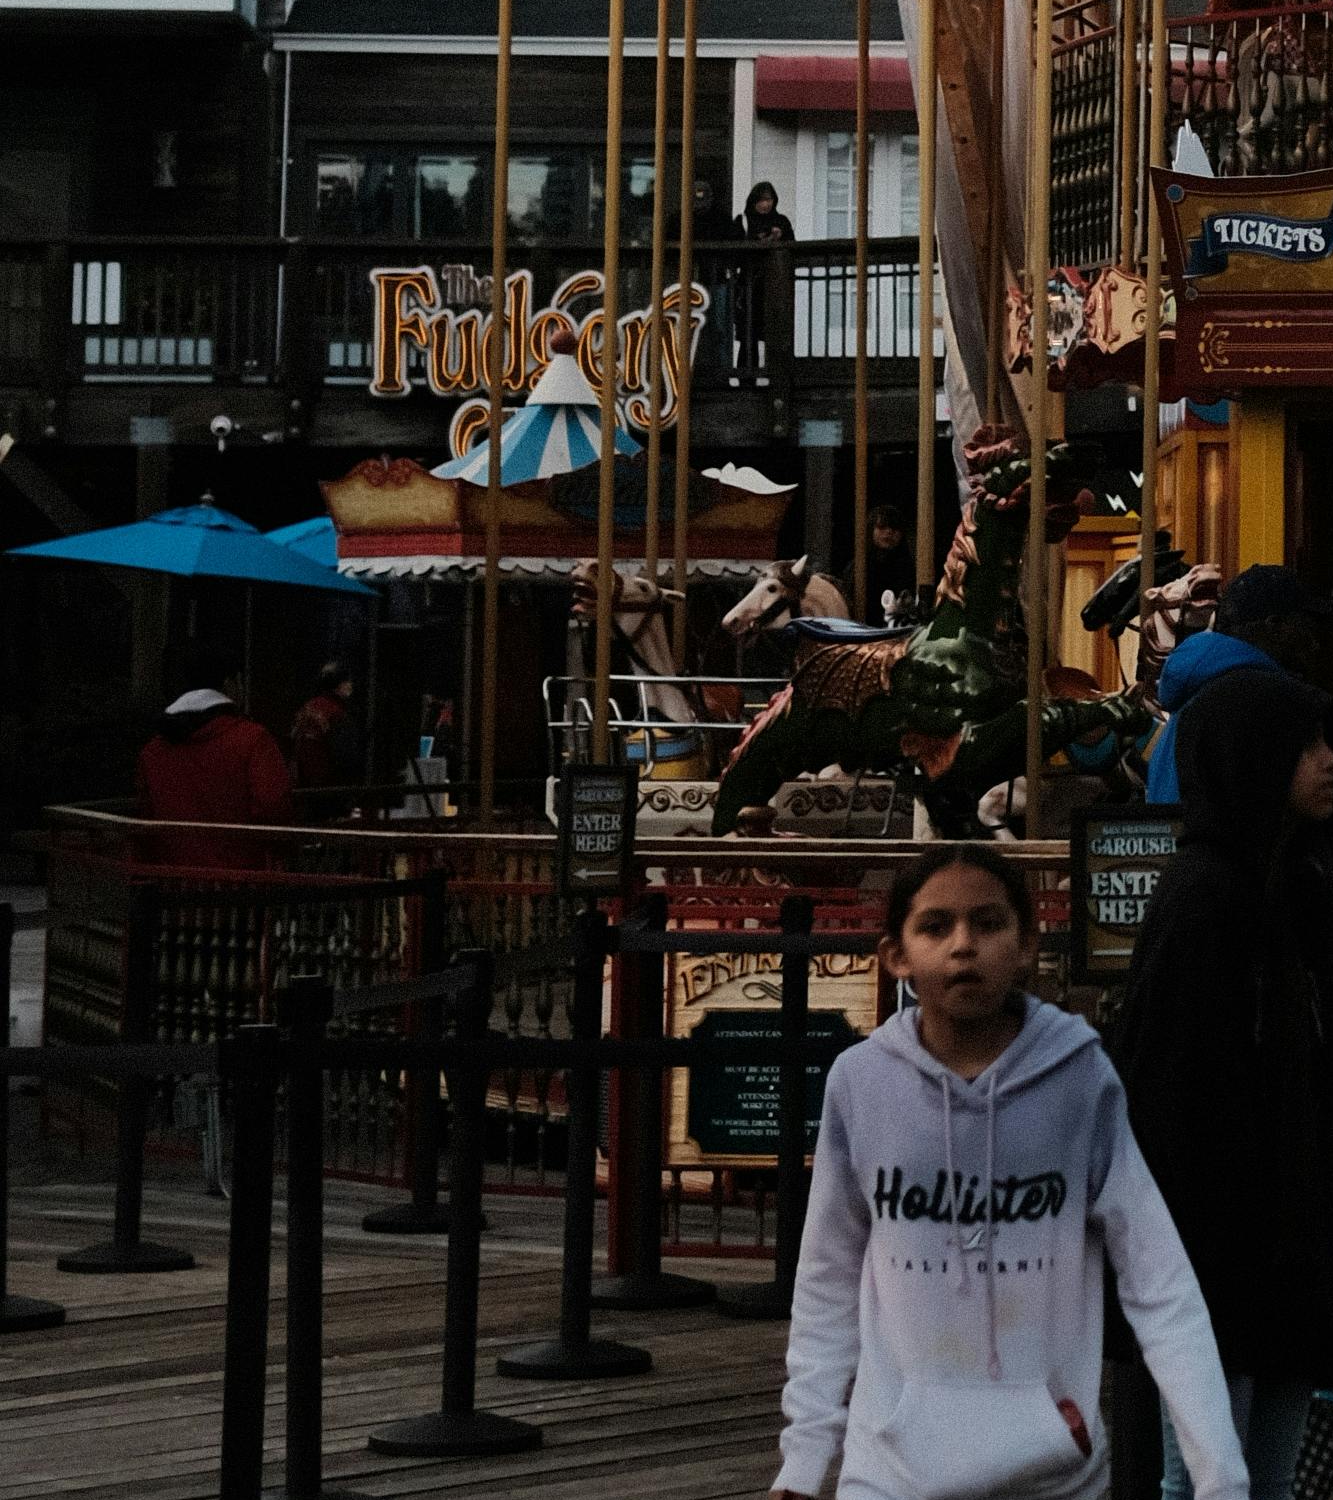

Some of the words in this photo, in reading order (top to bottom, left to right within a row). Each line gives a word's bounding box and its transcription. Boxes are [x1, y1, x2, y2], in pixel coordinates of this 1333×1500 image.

[1213, 218, 1327, 253] TICKETS
[572, 814, 622, 831] ENTER
[575, 834, 617, 851] HERE
[1091, 871, 1161, 896] ENTE
[1098, 899, 1149, 924] HE
[680, 952, 875, 1006] ENTRCE
[874, 1166, 1066, 1224] Hollister
[891, 1257, 1055, 1273] ALIORNI
